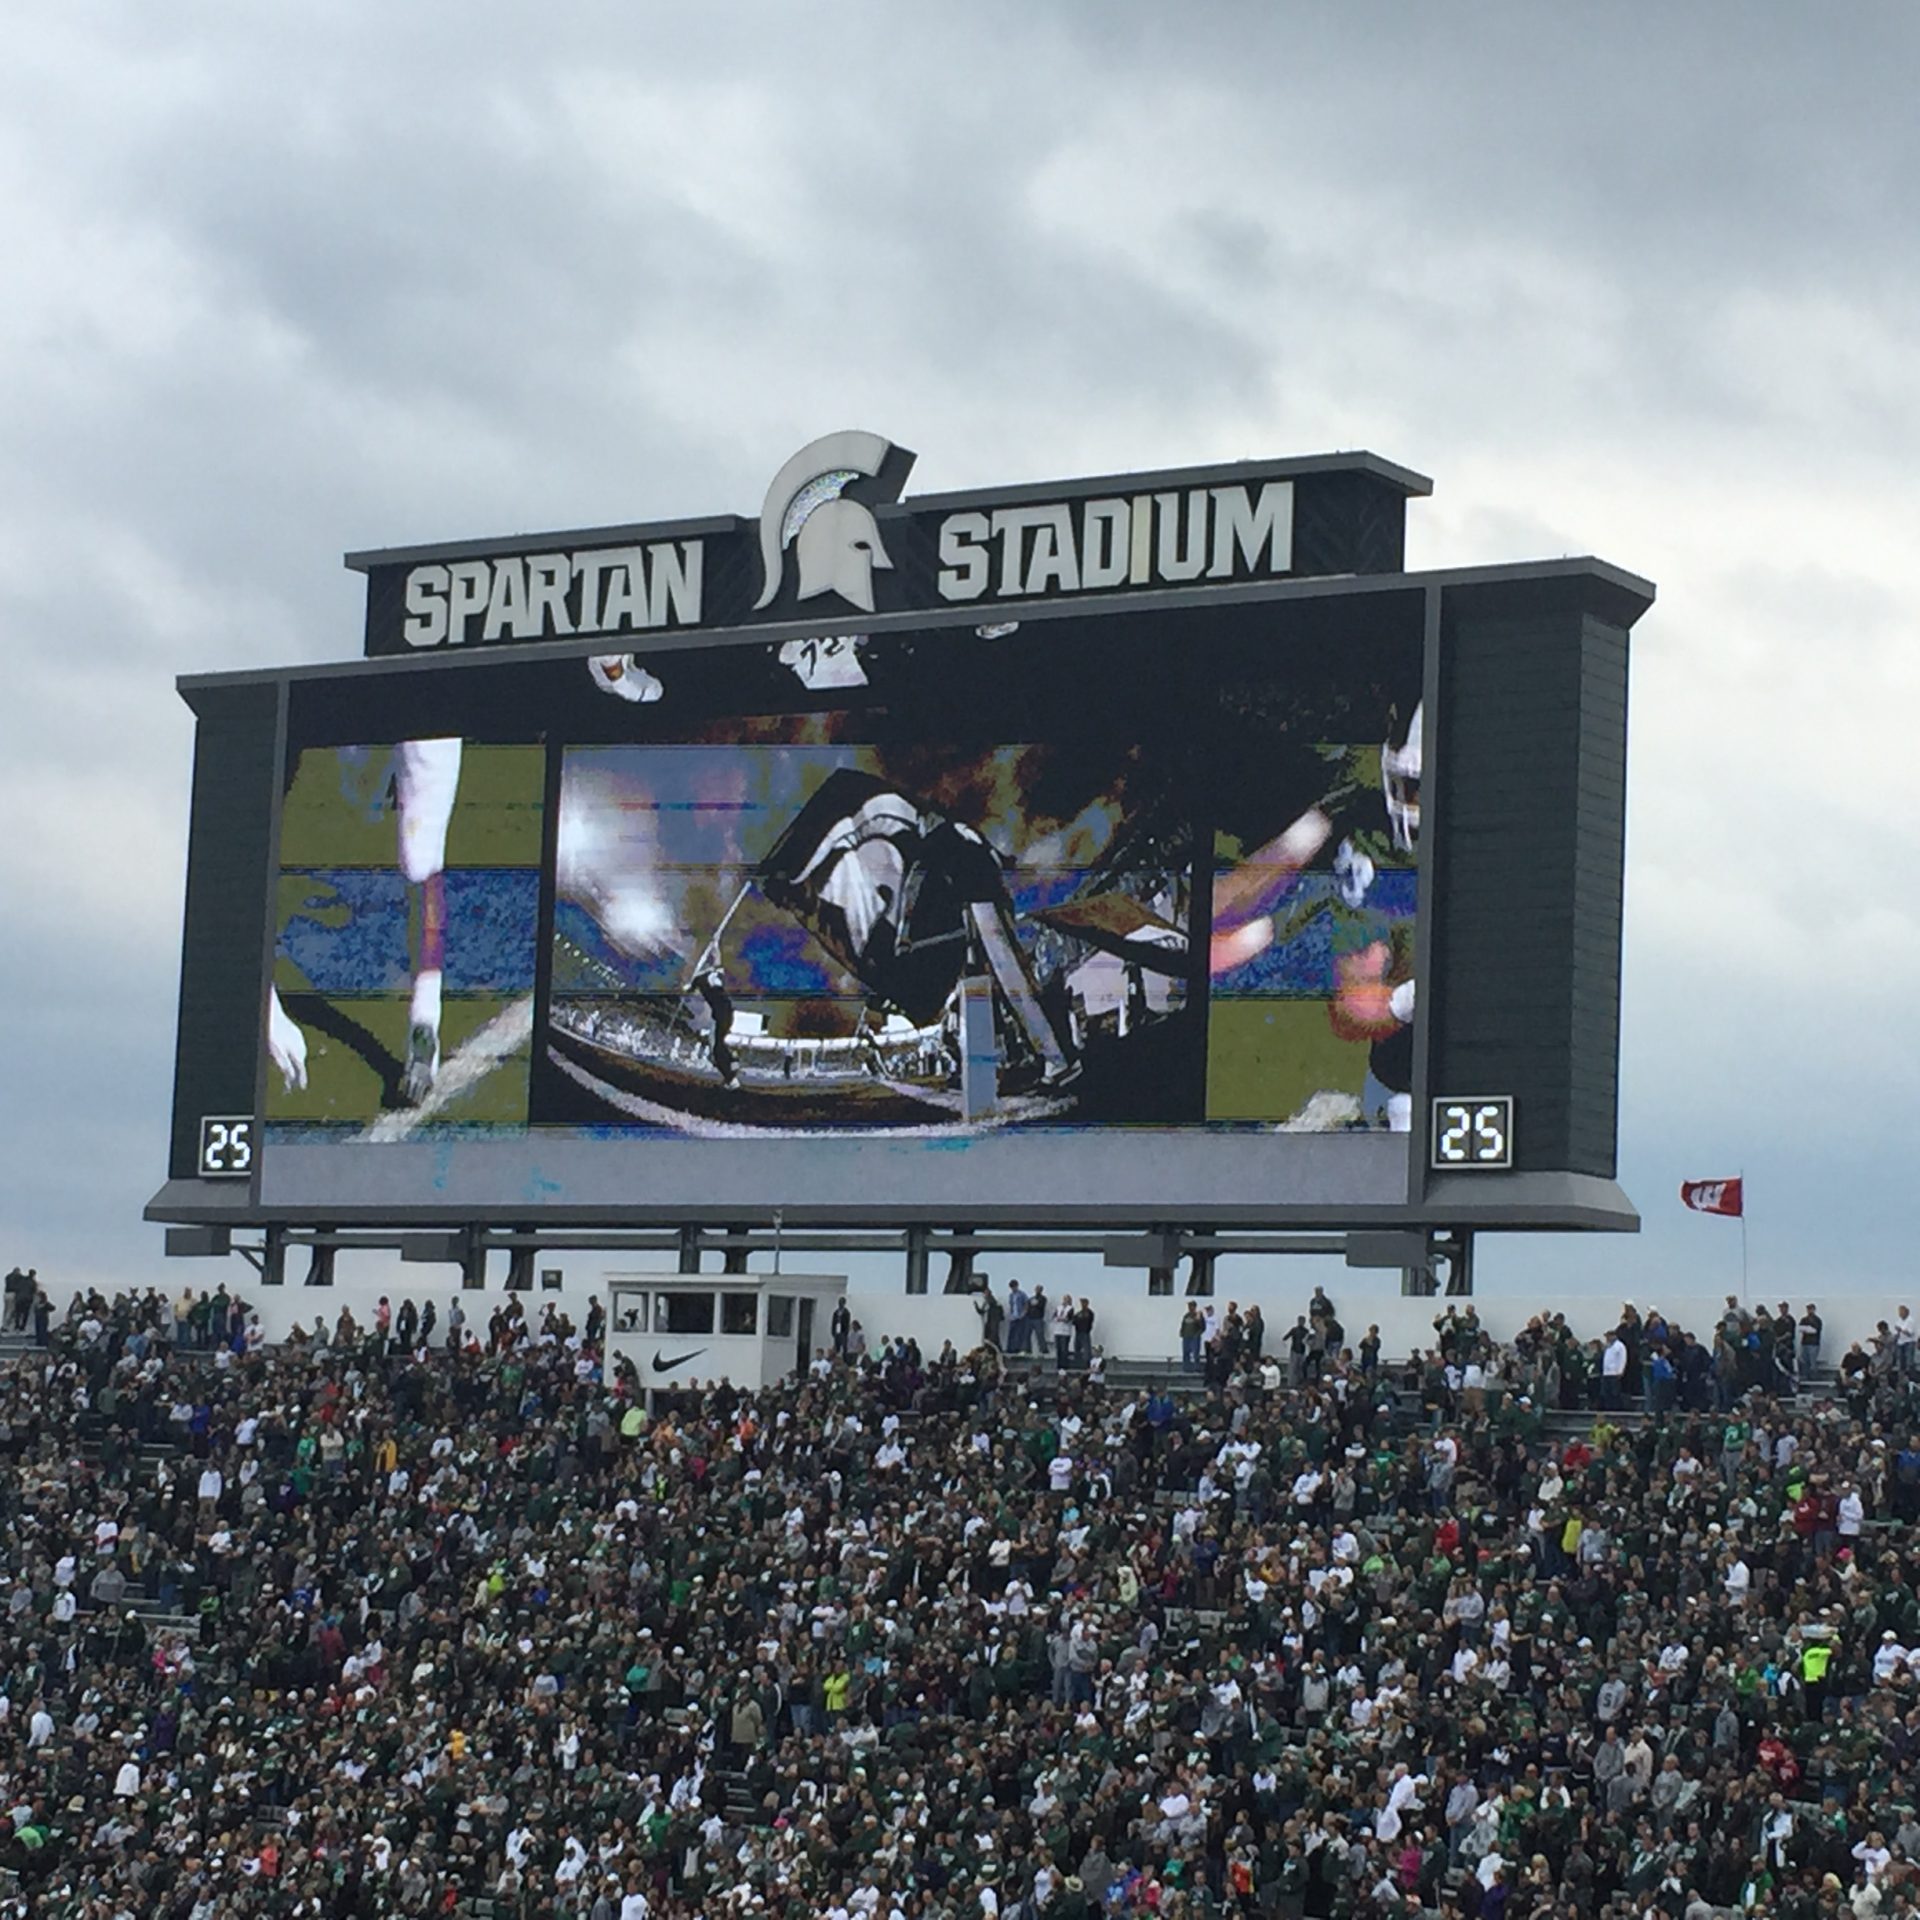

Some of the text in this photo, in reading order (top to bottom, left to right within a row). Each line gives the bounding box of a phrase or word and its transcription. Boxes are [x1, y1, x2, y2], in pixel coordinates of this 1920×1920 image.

[403, 480, 1294, 647] SPARTAN STADIUM
[206, 1124, 250, 1168] 25
[1442, 1106, 1503, 1160] 25
